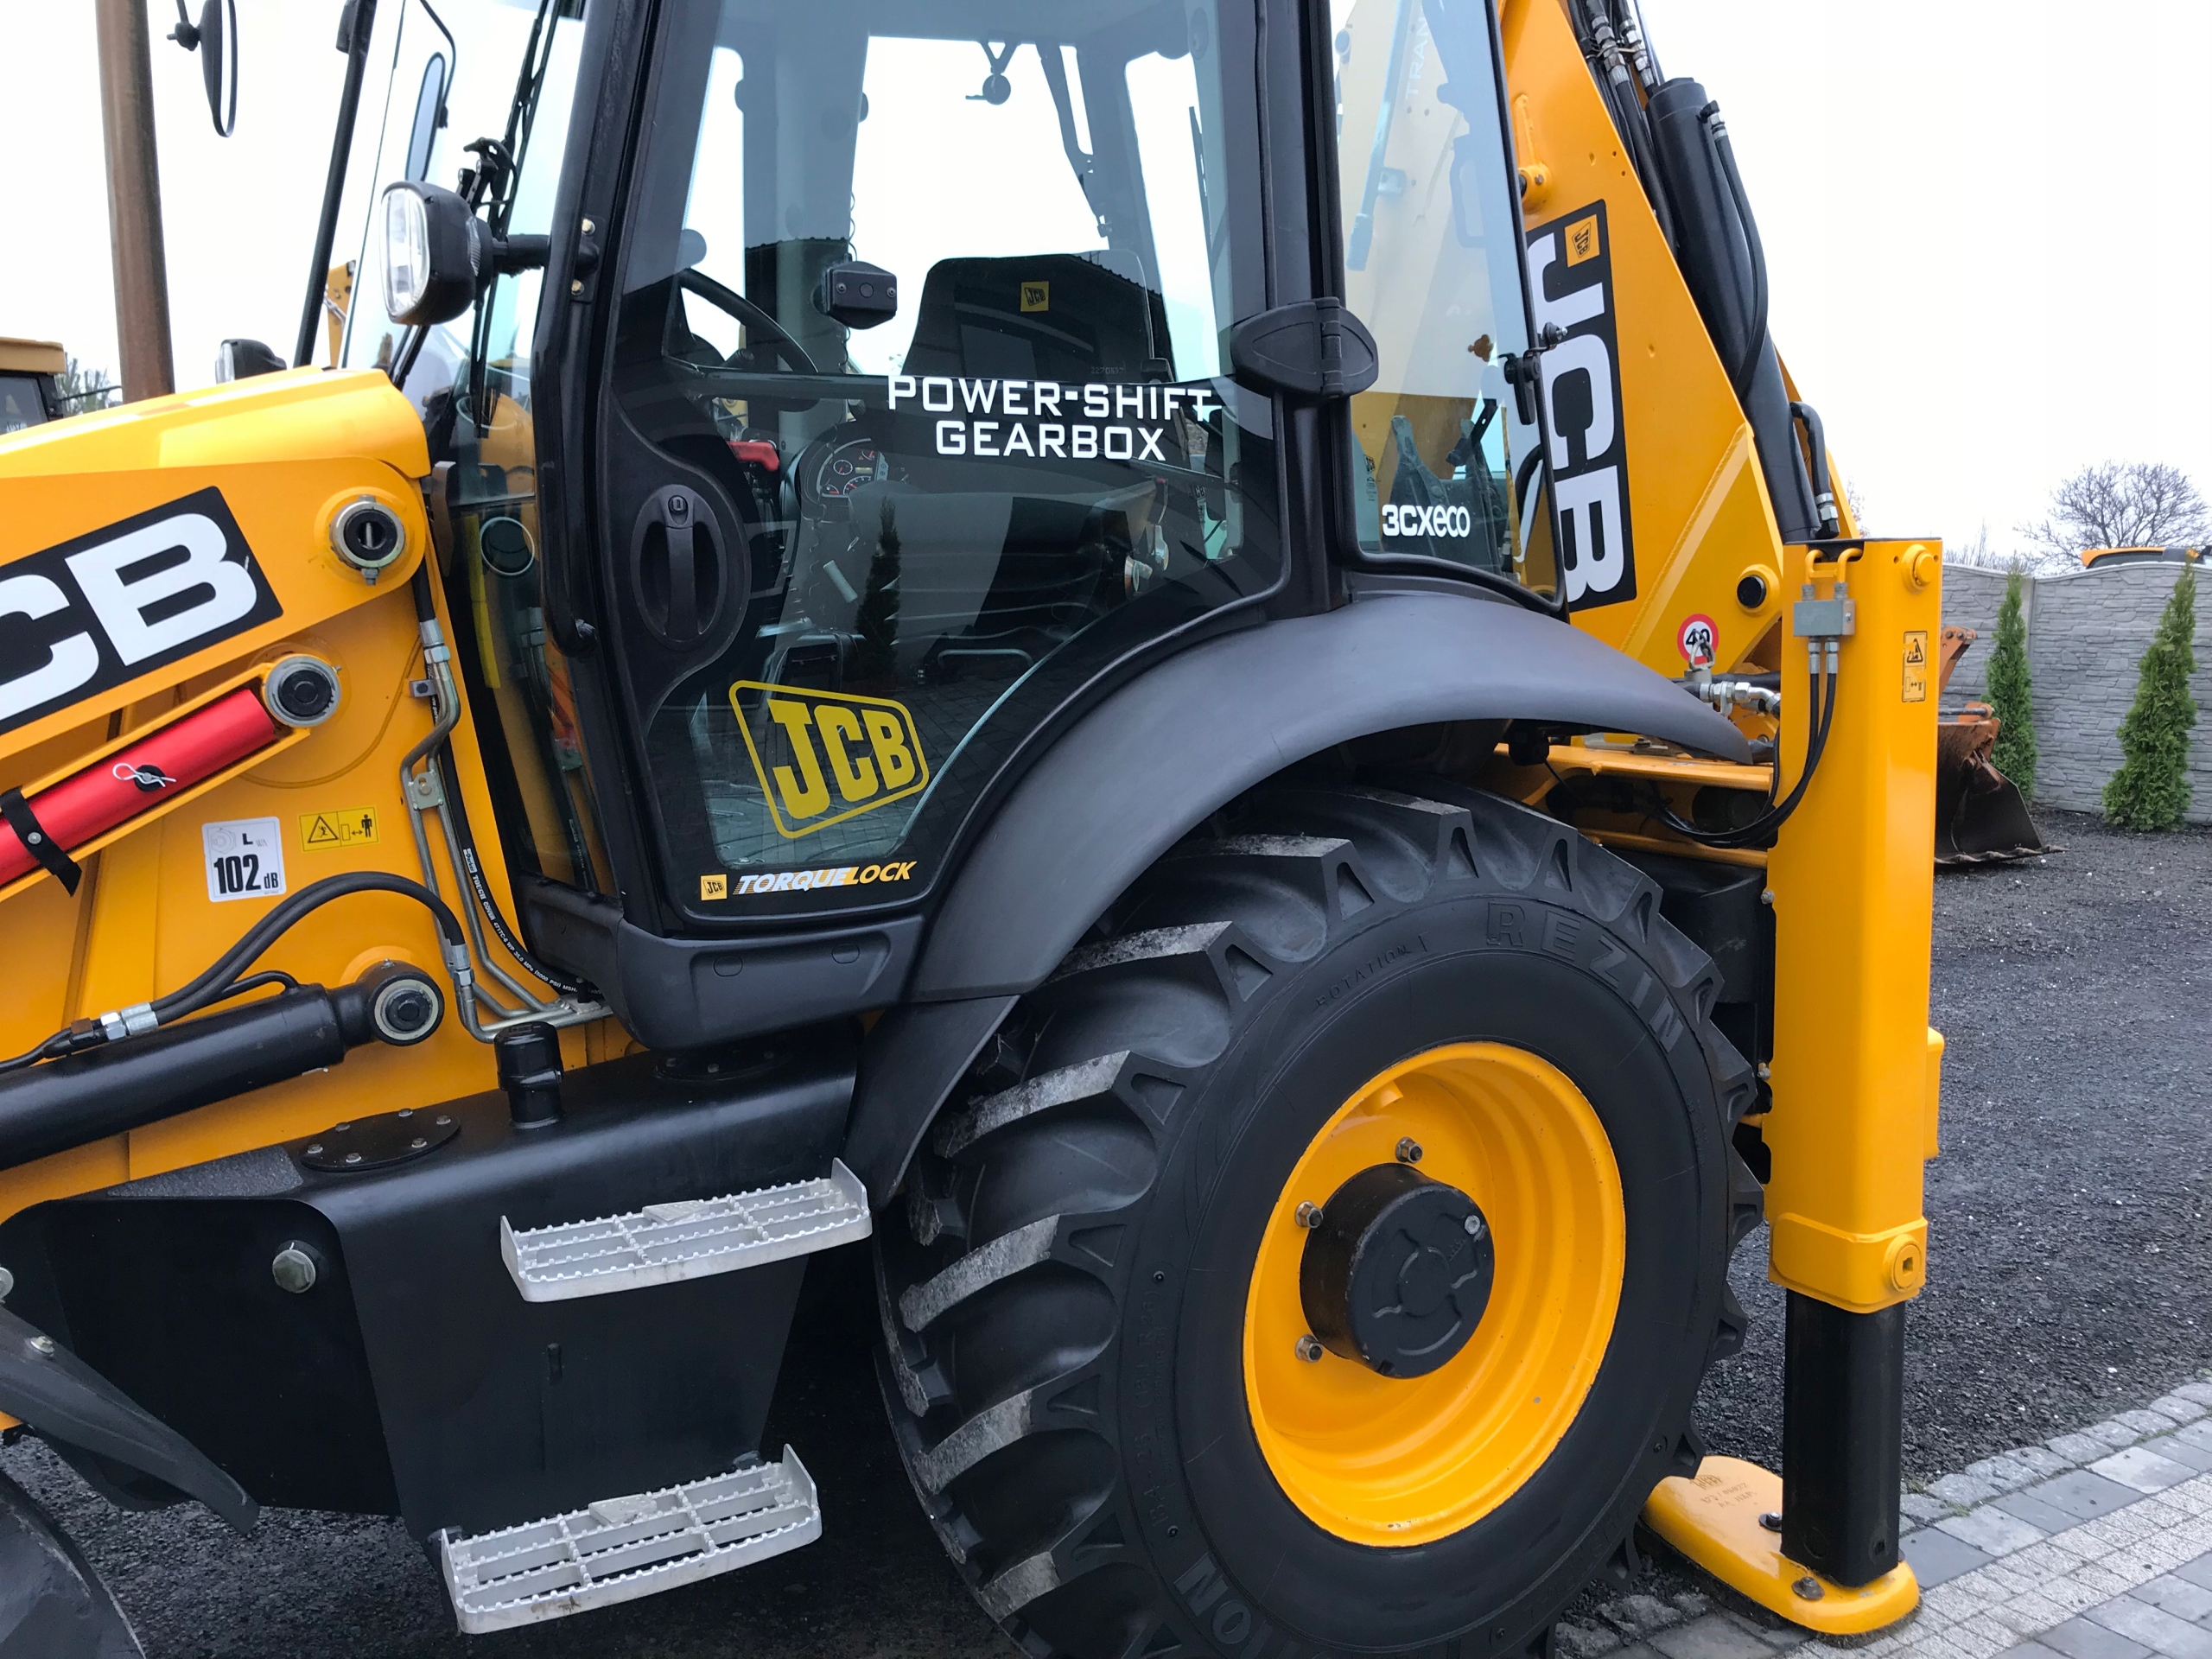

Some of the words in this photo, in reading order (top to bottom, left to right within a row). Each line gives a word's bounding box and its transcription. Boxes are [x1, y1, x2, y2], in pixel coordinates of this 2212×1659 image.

[1573, 227, 1590, 256] JCB
[1026, 288, 1046, 305] JCB
[887, 374, 1212, 423] POWER-SHIFT
[1527, 232, 1625, 603] JCB
[935, 420, 1166, 461] GEARBOX
[1382, 504, 1471, 537] 3CXeco
[767, 697, 916, 820] JCB
[213, 854, 262, 894] 102
[264, 872, 279, 890] dB
[707, 880, 723, 894] JCB
[473, 875, 486, 899] TOUGH
[483, 901, 495, 921] COVER
[505, 941, 516, 952] WP
